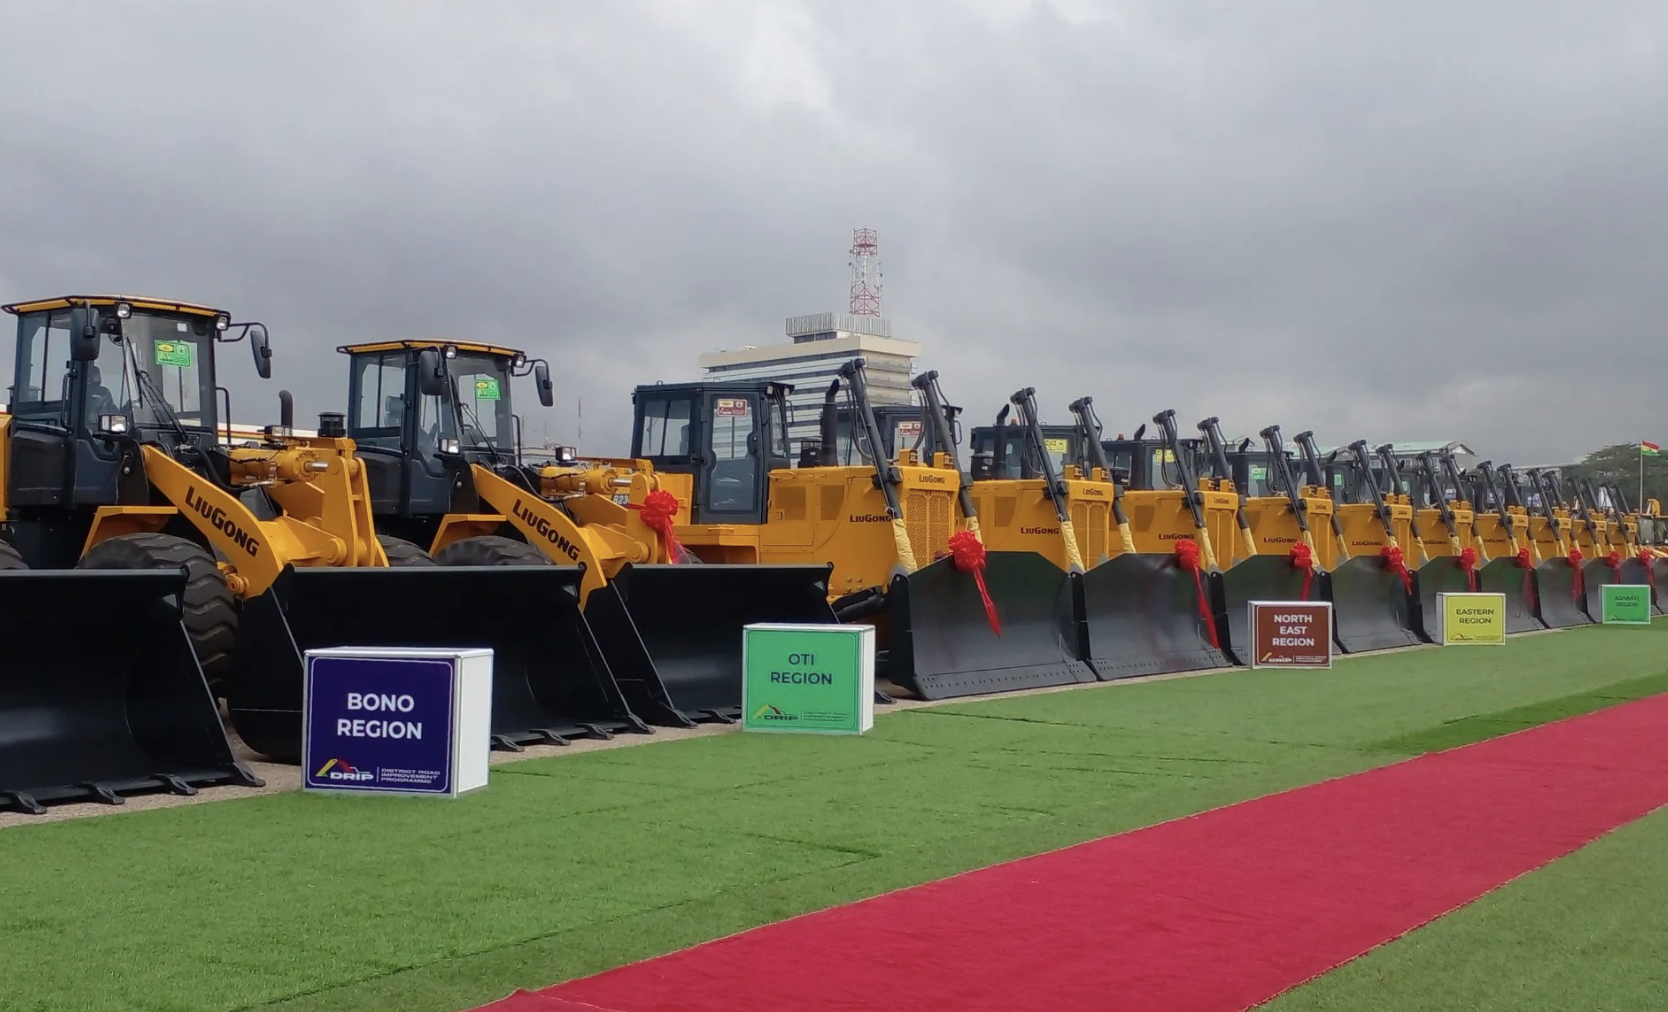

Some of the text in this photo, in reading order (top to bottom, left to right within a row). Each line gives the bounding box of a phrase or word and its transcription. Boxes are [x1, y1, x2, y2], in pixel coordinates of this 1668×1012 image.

[1274, 614, 1312, 623] NORTH
[1280, 626, 1307, 634] EAST
[1272, 637, 1314, 646] REGION
[788, 653, 814, 665] OTI
[770, 671, 832, 685] REGION
[347, 692, 415, 712] BONO
[337, 718, 422, 740] REGION
[330, 772, 374, 781] DRIP
